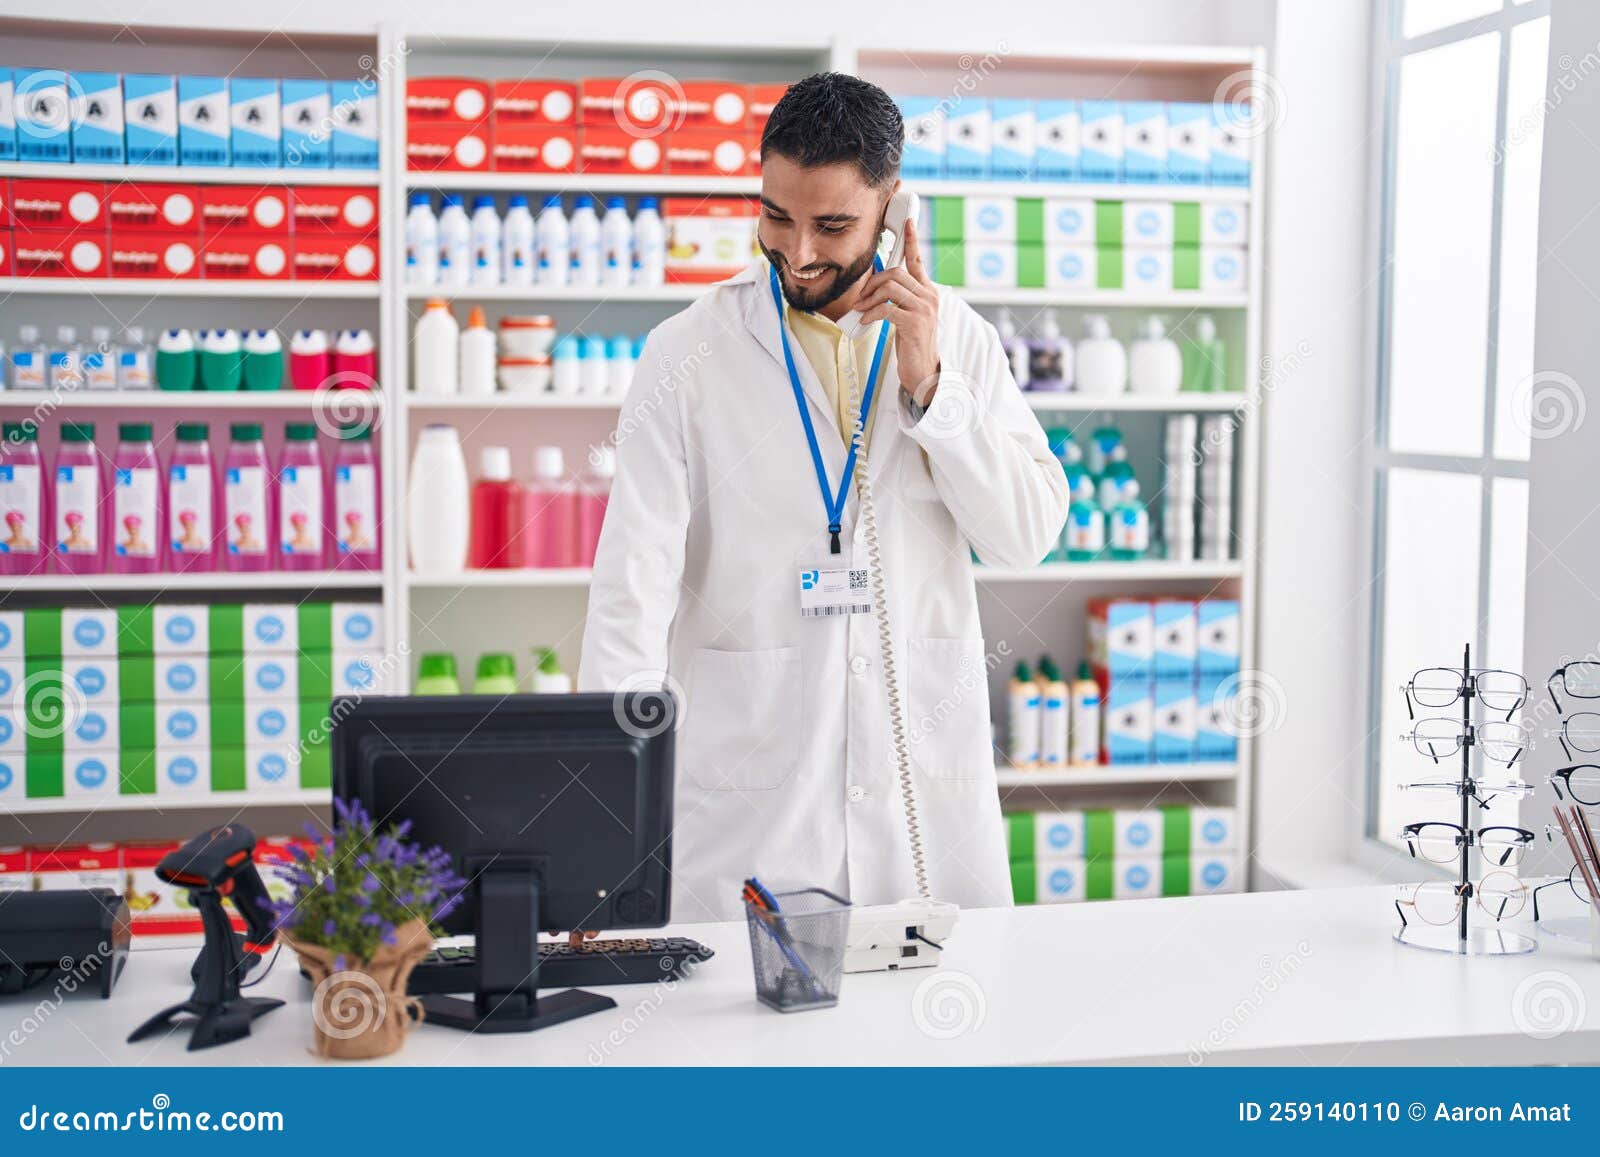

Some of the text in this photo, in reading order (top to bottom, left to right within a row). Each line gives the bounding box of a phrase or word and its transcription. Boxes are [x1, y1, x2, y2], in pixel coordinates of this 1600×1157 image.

[87, 101, 103, 117] A
[142, 104, 157, 119] A
[195, 106, 210, 121] A
